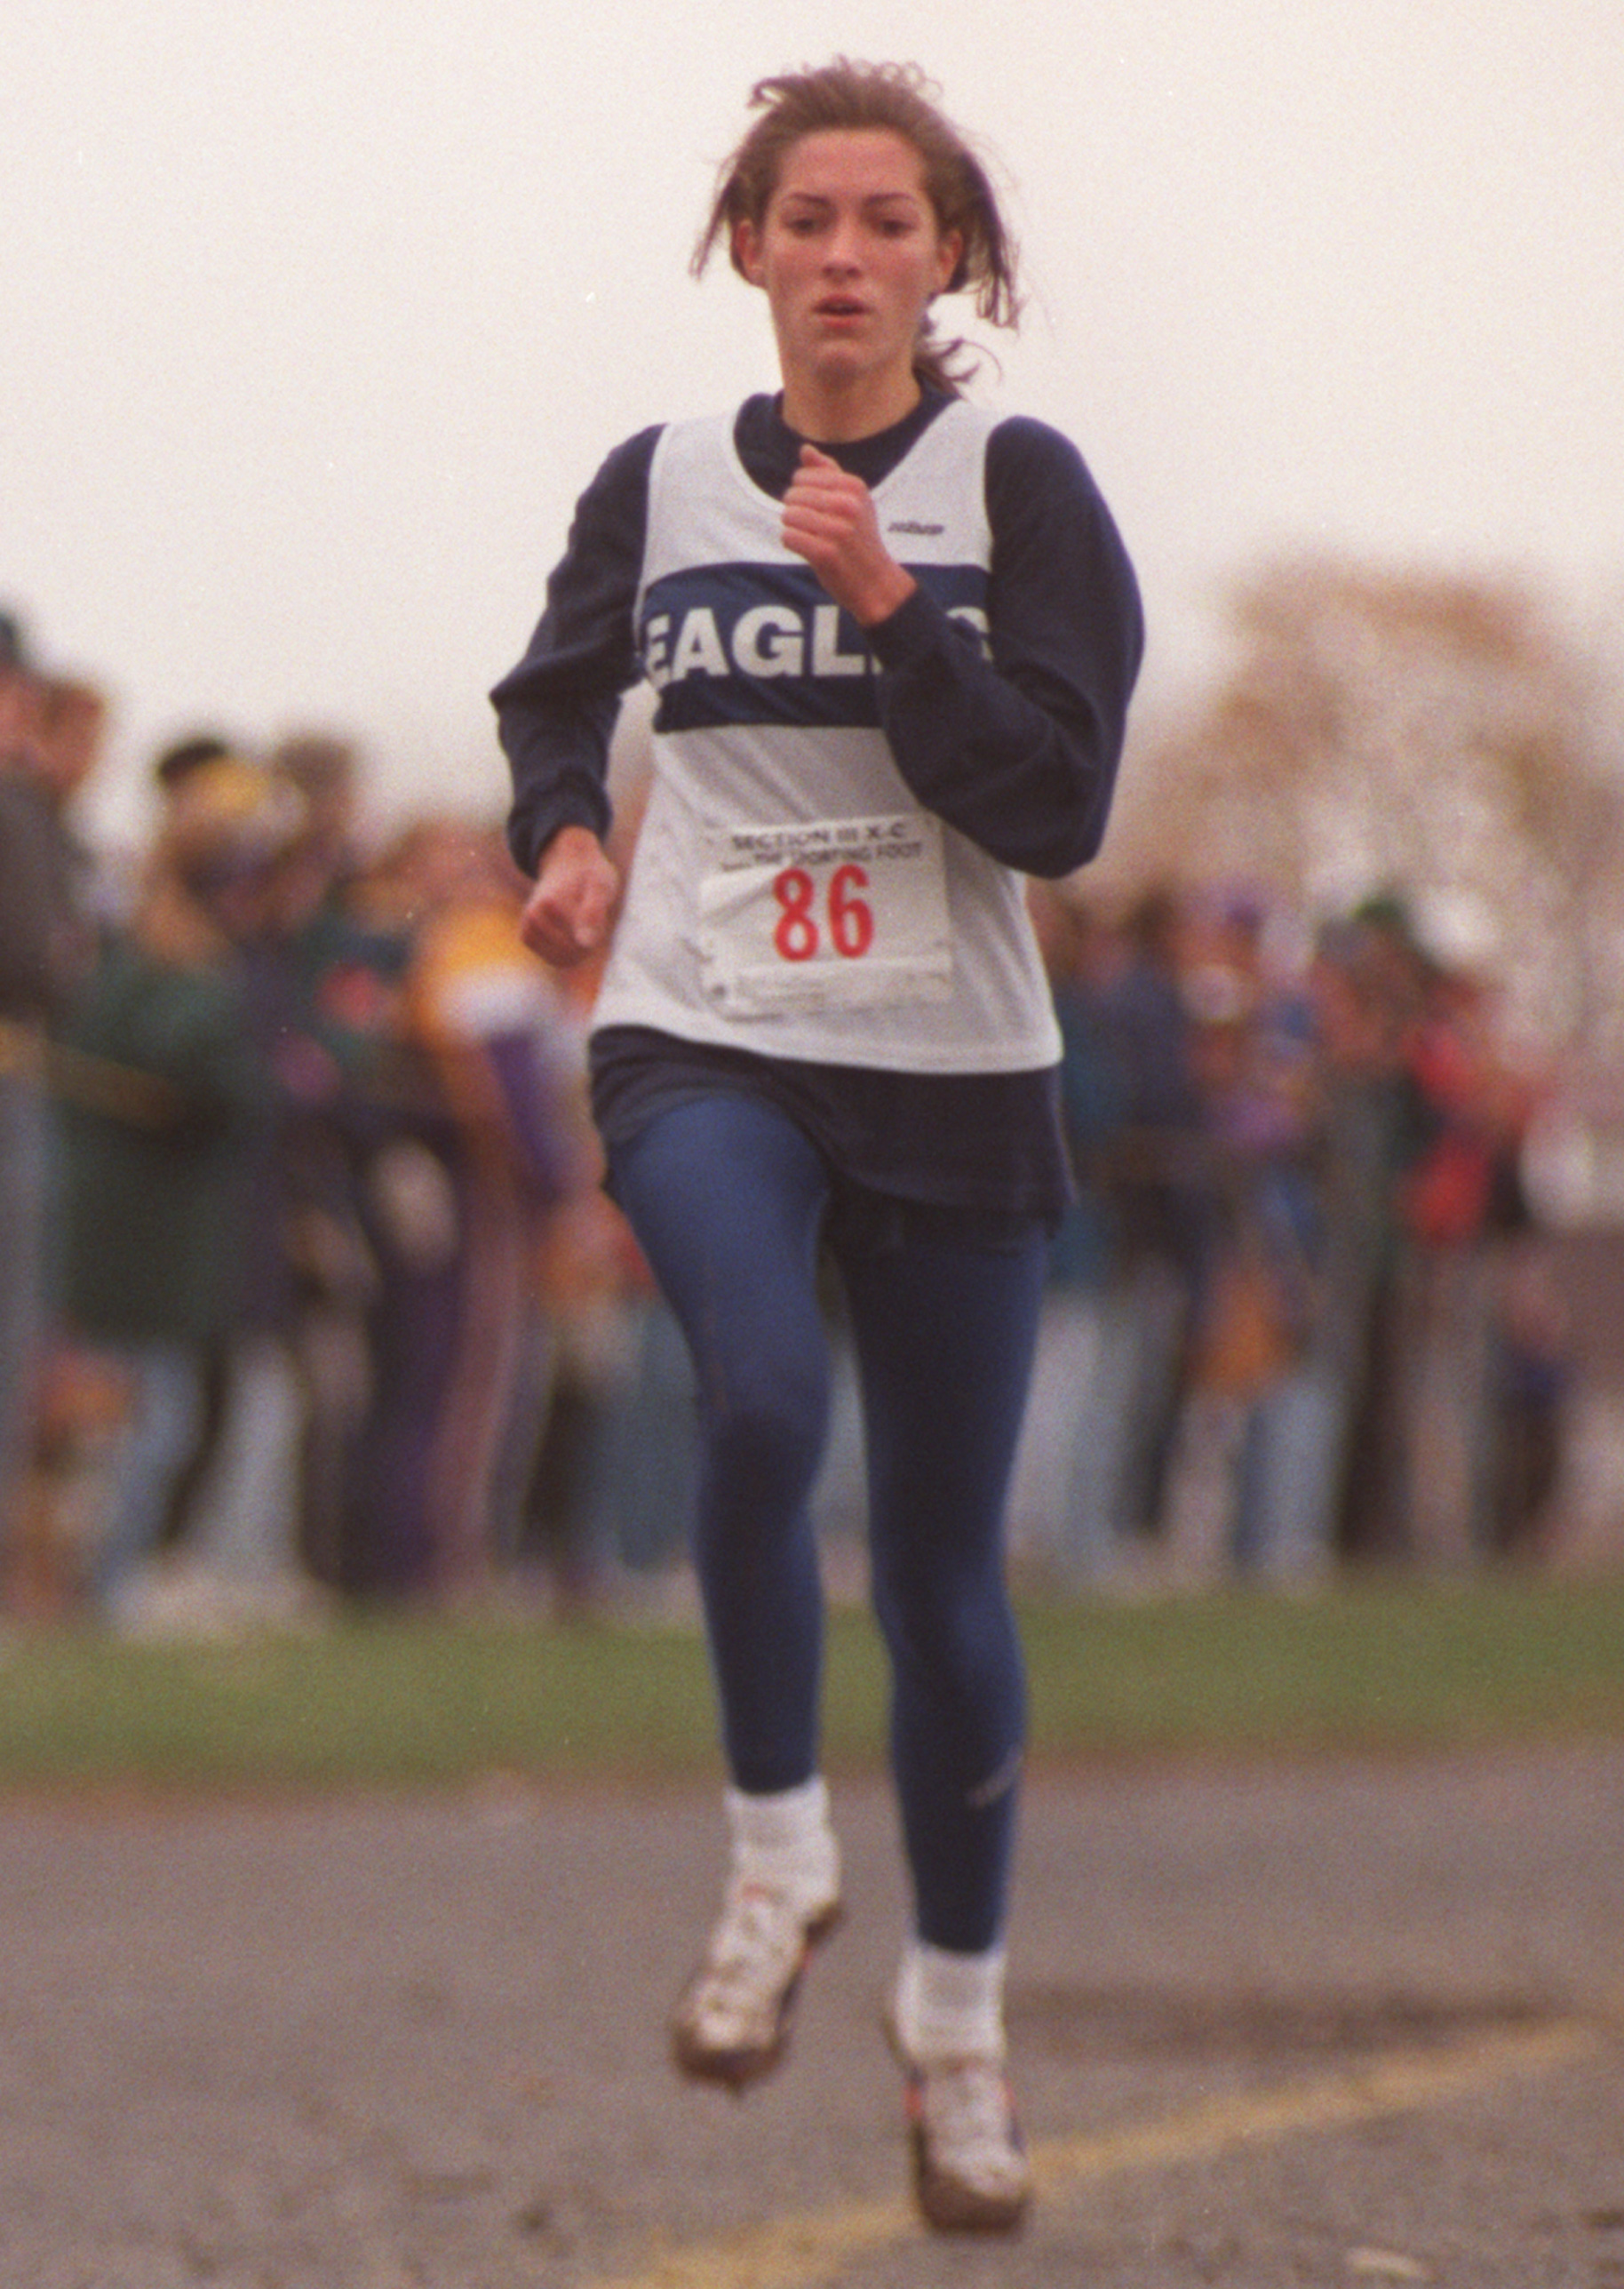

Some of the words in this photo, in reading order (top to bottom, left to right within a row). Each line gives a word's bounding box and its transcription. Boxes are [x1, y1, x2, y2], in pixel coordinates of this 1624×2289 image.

[646, 604, 992, 690] EAGL
[731, 830, 831, 851] SECTION
[772, 863, 874, 963] 86
